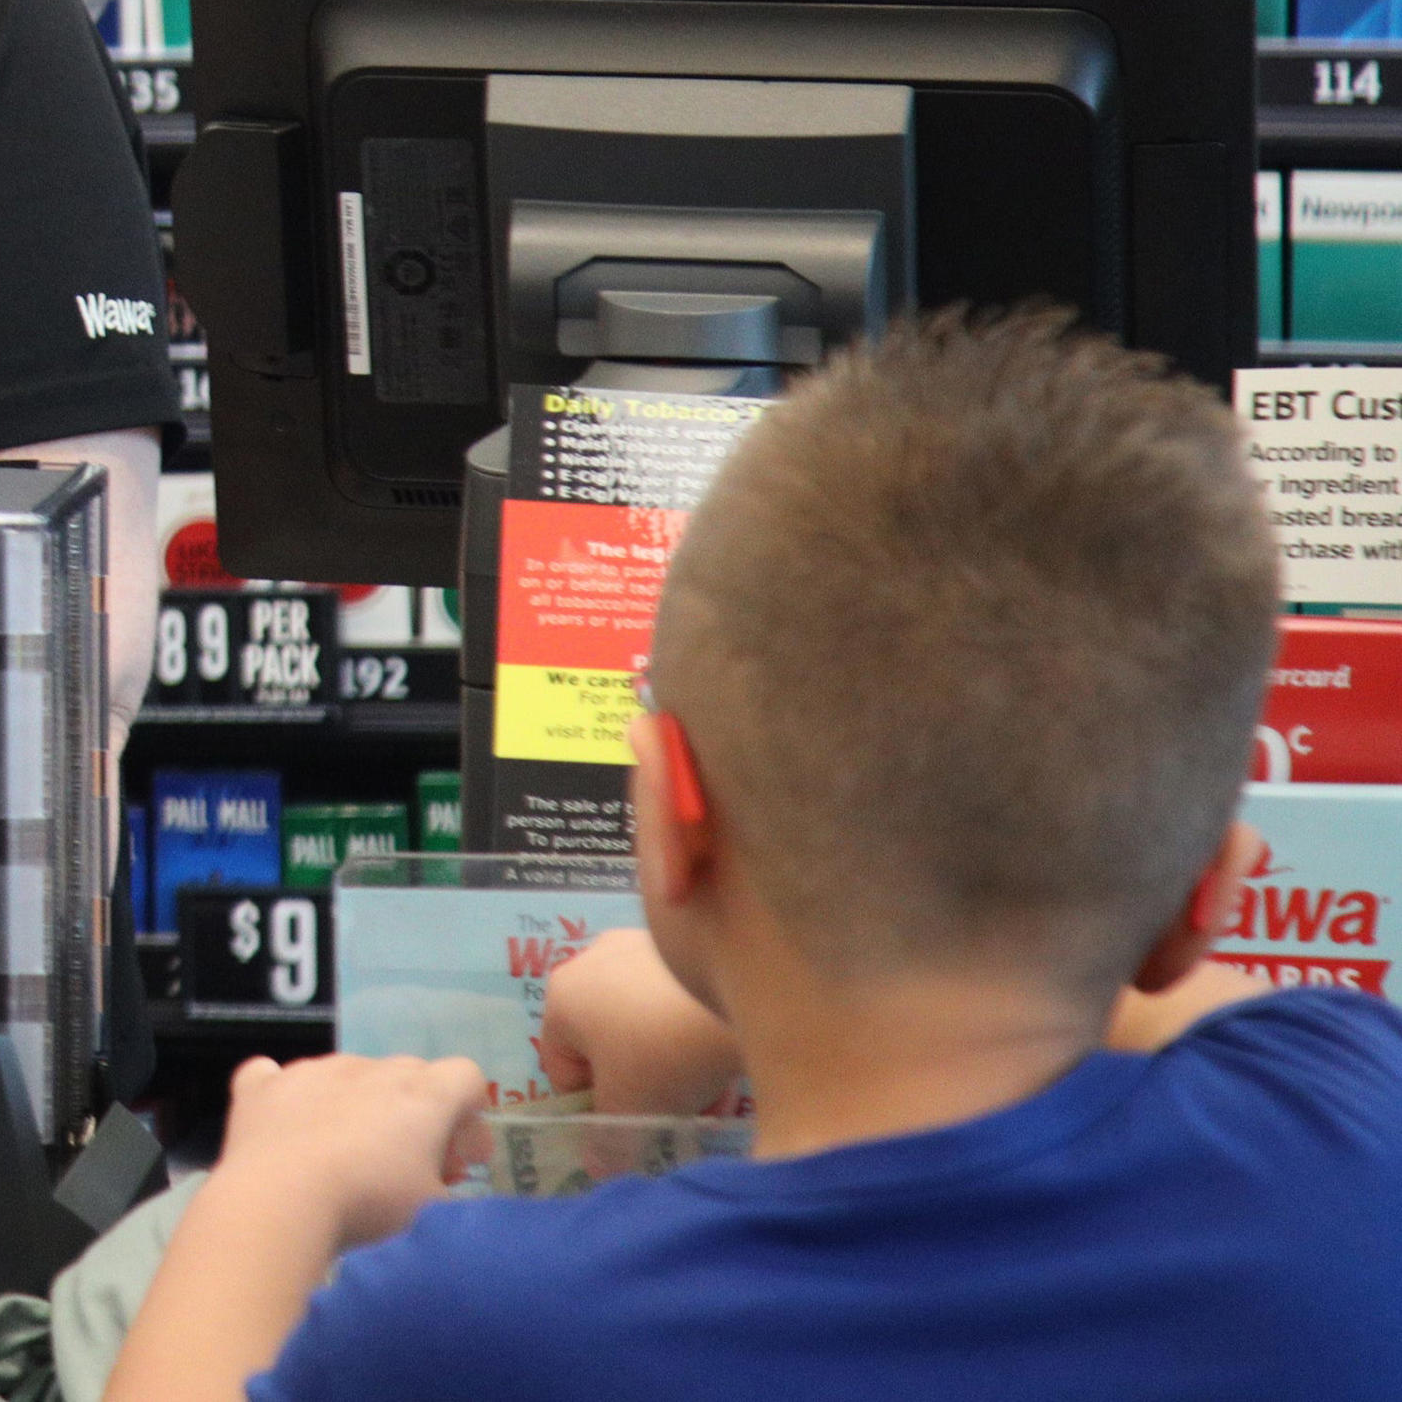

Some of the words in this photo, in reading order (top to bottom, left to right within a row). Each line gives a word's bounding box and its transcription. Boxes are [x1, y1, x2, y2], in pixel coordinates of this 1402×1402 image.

[1313, 60, 1383, 105] 114
[76, 293, 153, 339] Wawa
[544, 394, 616, 419] Daily
[623, 399, 740, 423] Tobacco
[1251, 390, 1319, 421] EBT
[1331, 389, 1402, 422] Cust
[1250, 442, 1365, 466] According
[1374, 442, 1396, 462] to
[250, 599, 311, 642] PER
[241, 642, 322, 689] PACK
[547, 671, 580, 688] We
[587, 672, 634, 690] card
[579, 690, 608, 706] For
[545, 724, 585, 741] visit
[592, 726, 625, 743] the
[160, 797, 209, 833] PALL
[218, 795, 269, 831] MALL
[526, 795, 560, 812] The
[562, 799, 598, 814] sale
[601, 799, 623, 814] of
[506, 814, 566, 830] person
[569, 818, 621, 833] under
[526, 831, 550, 847] To
[552, 833, 632, 853] purchase
[518, 913, 551, 932] The
